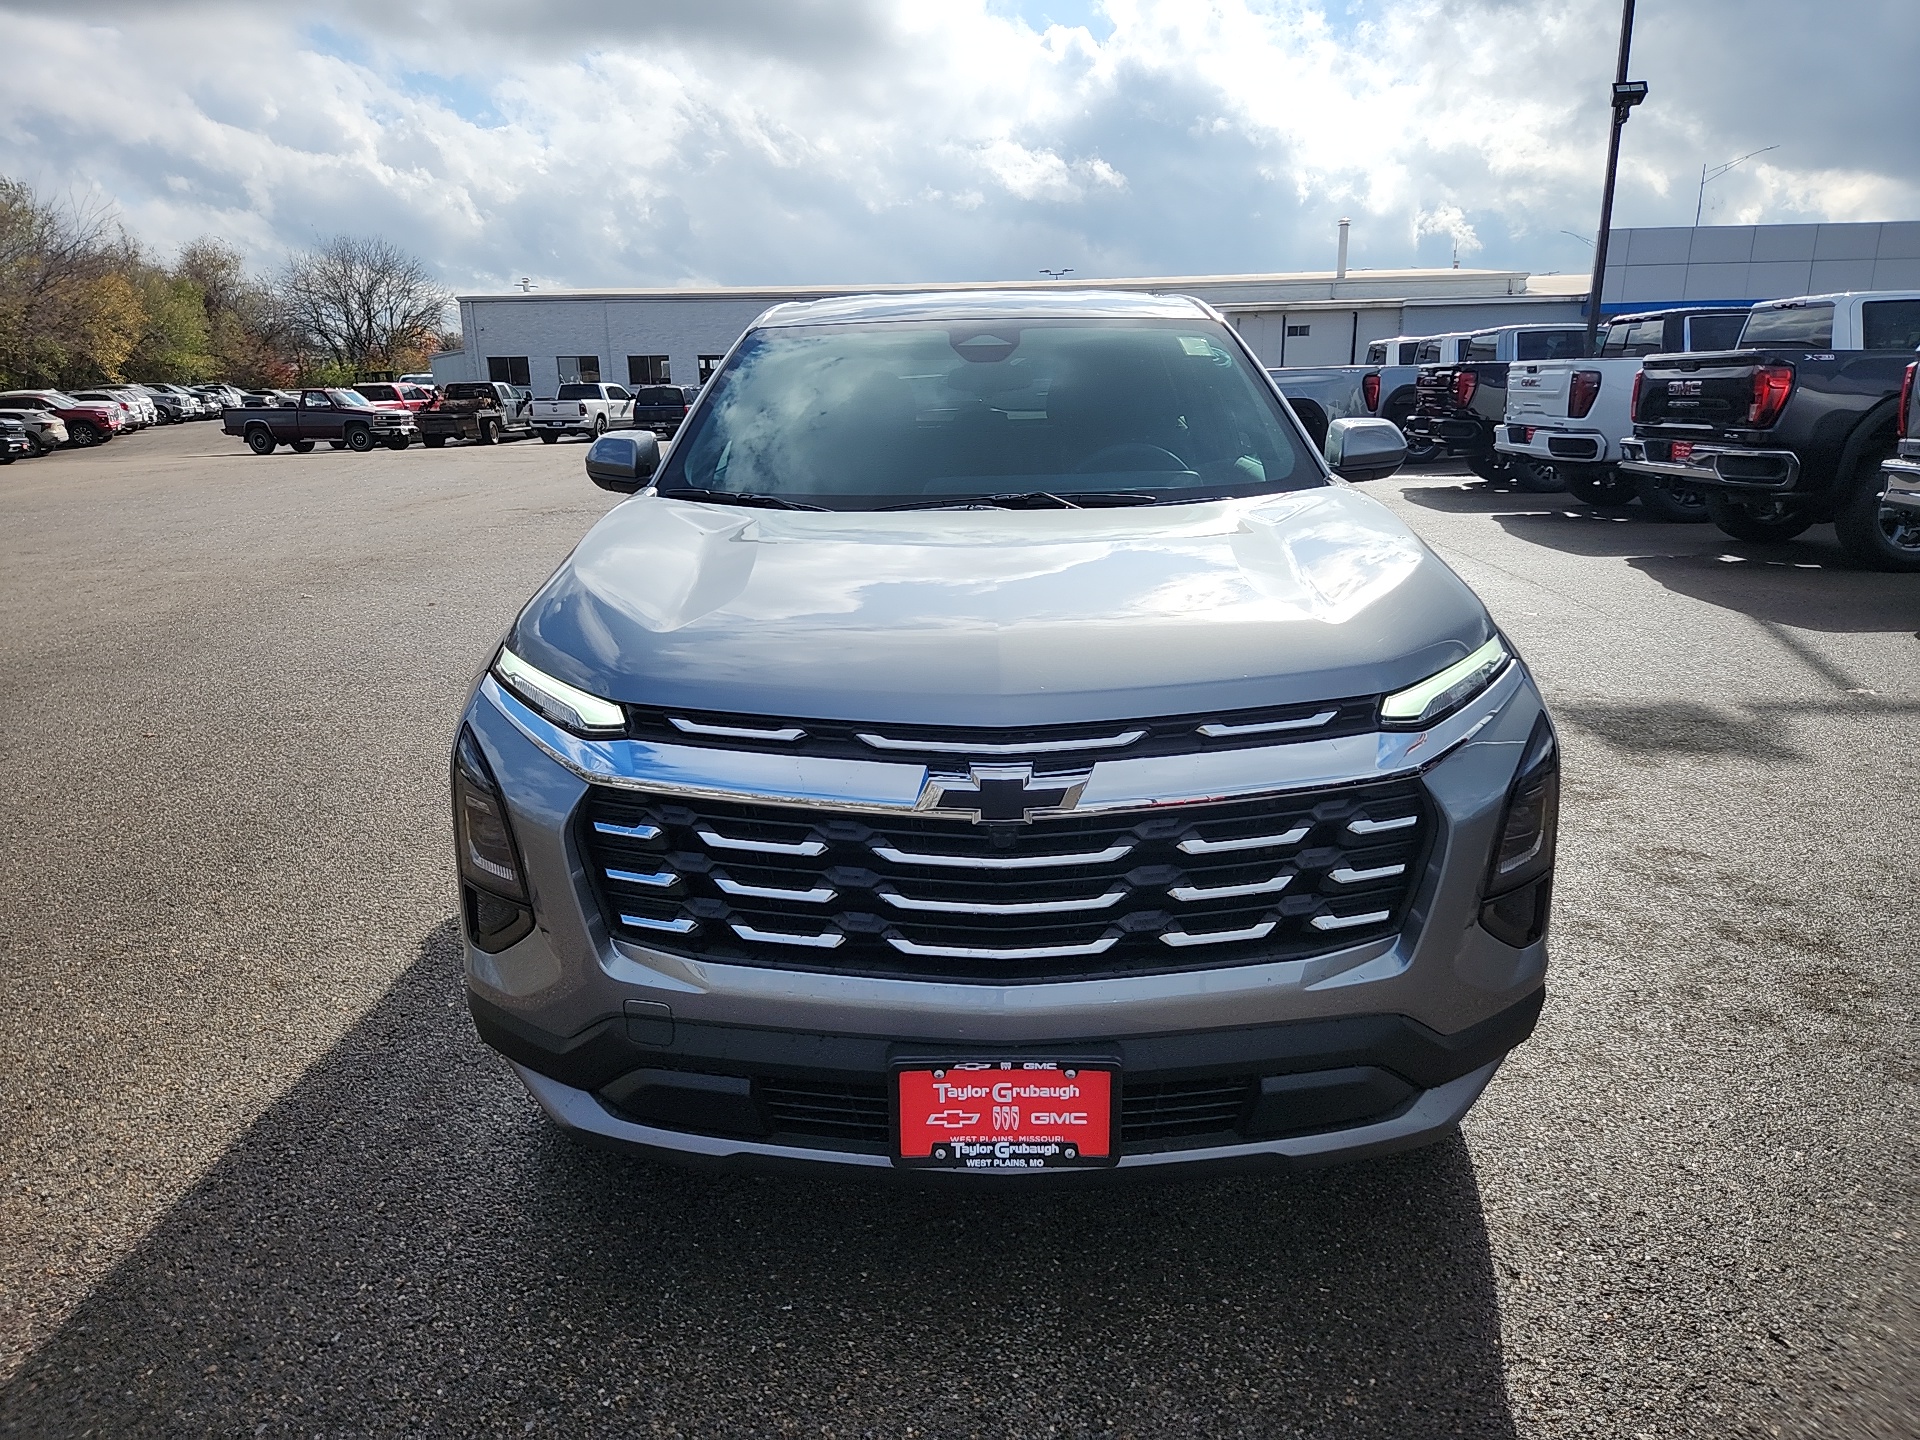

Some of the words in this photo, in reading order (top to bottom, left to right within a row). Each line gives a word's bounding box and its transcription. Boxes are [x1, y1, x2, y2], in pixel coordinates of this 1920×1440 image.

[933, 1083, 989, 1103] Taylor
[992, 1083, 1080, 1103] Grubaugh
[1030, 1112, 1088, 1125] GMC
[950, 1142, 993, 1158] Taylor
[994, 1142, 1060, 1158] Grubaugh
[966, 1159, 992, 1167] WEST
[993, 1159, 1028, 1168] PLAINS,
[1029, 1159, 1044, 1167] MO
